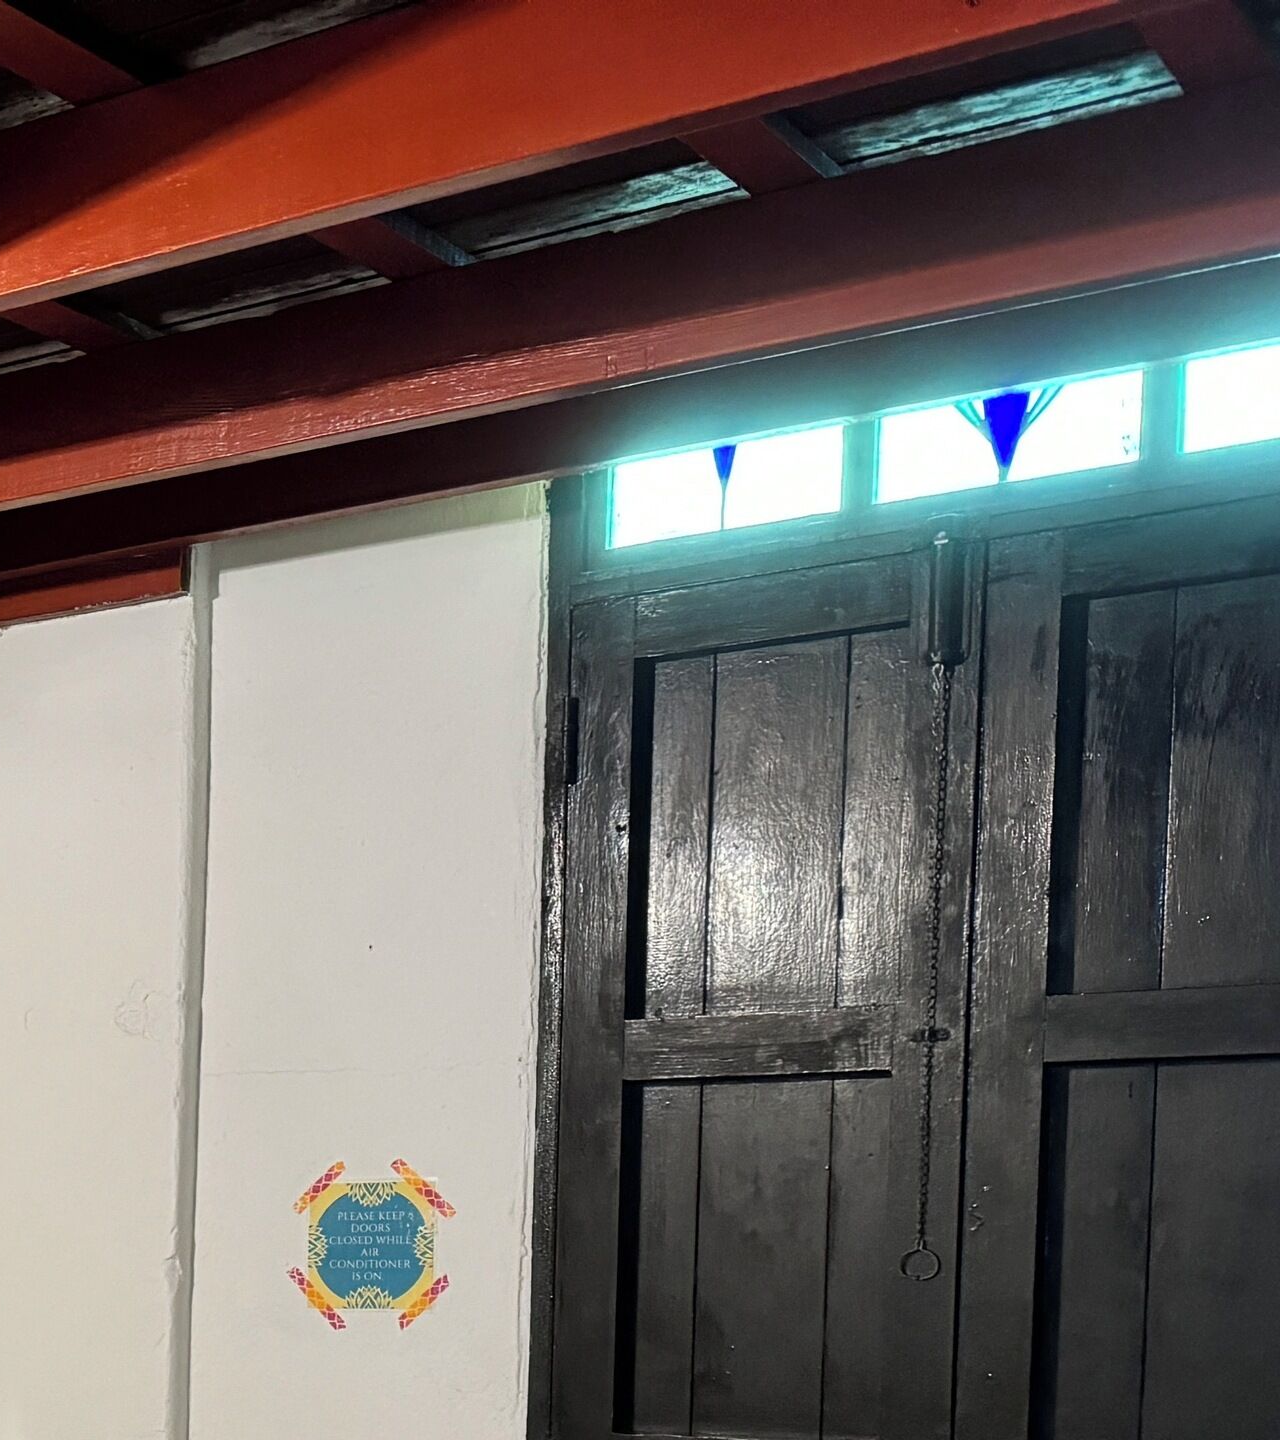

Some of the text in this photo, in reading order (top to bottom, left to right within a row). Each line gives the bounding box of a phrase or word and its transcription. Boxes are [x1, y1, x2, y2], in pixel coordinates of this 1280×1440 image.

[337, 1211, 405, 1221] PLEASE KEEP
[351, 1223, 391, 1233] DOORS
[329, 1235, 412, 1245] CLOSED WHILE
[360, 1247, 380, 1257] AIR
[329, 1259, 411, 1269] CONDITIONER
[352, 1271, 361, 1281] IS
